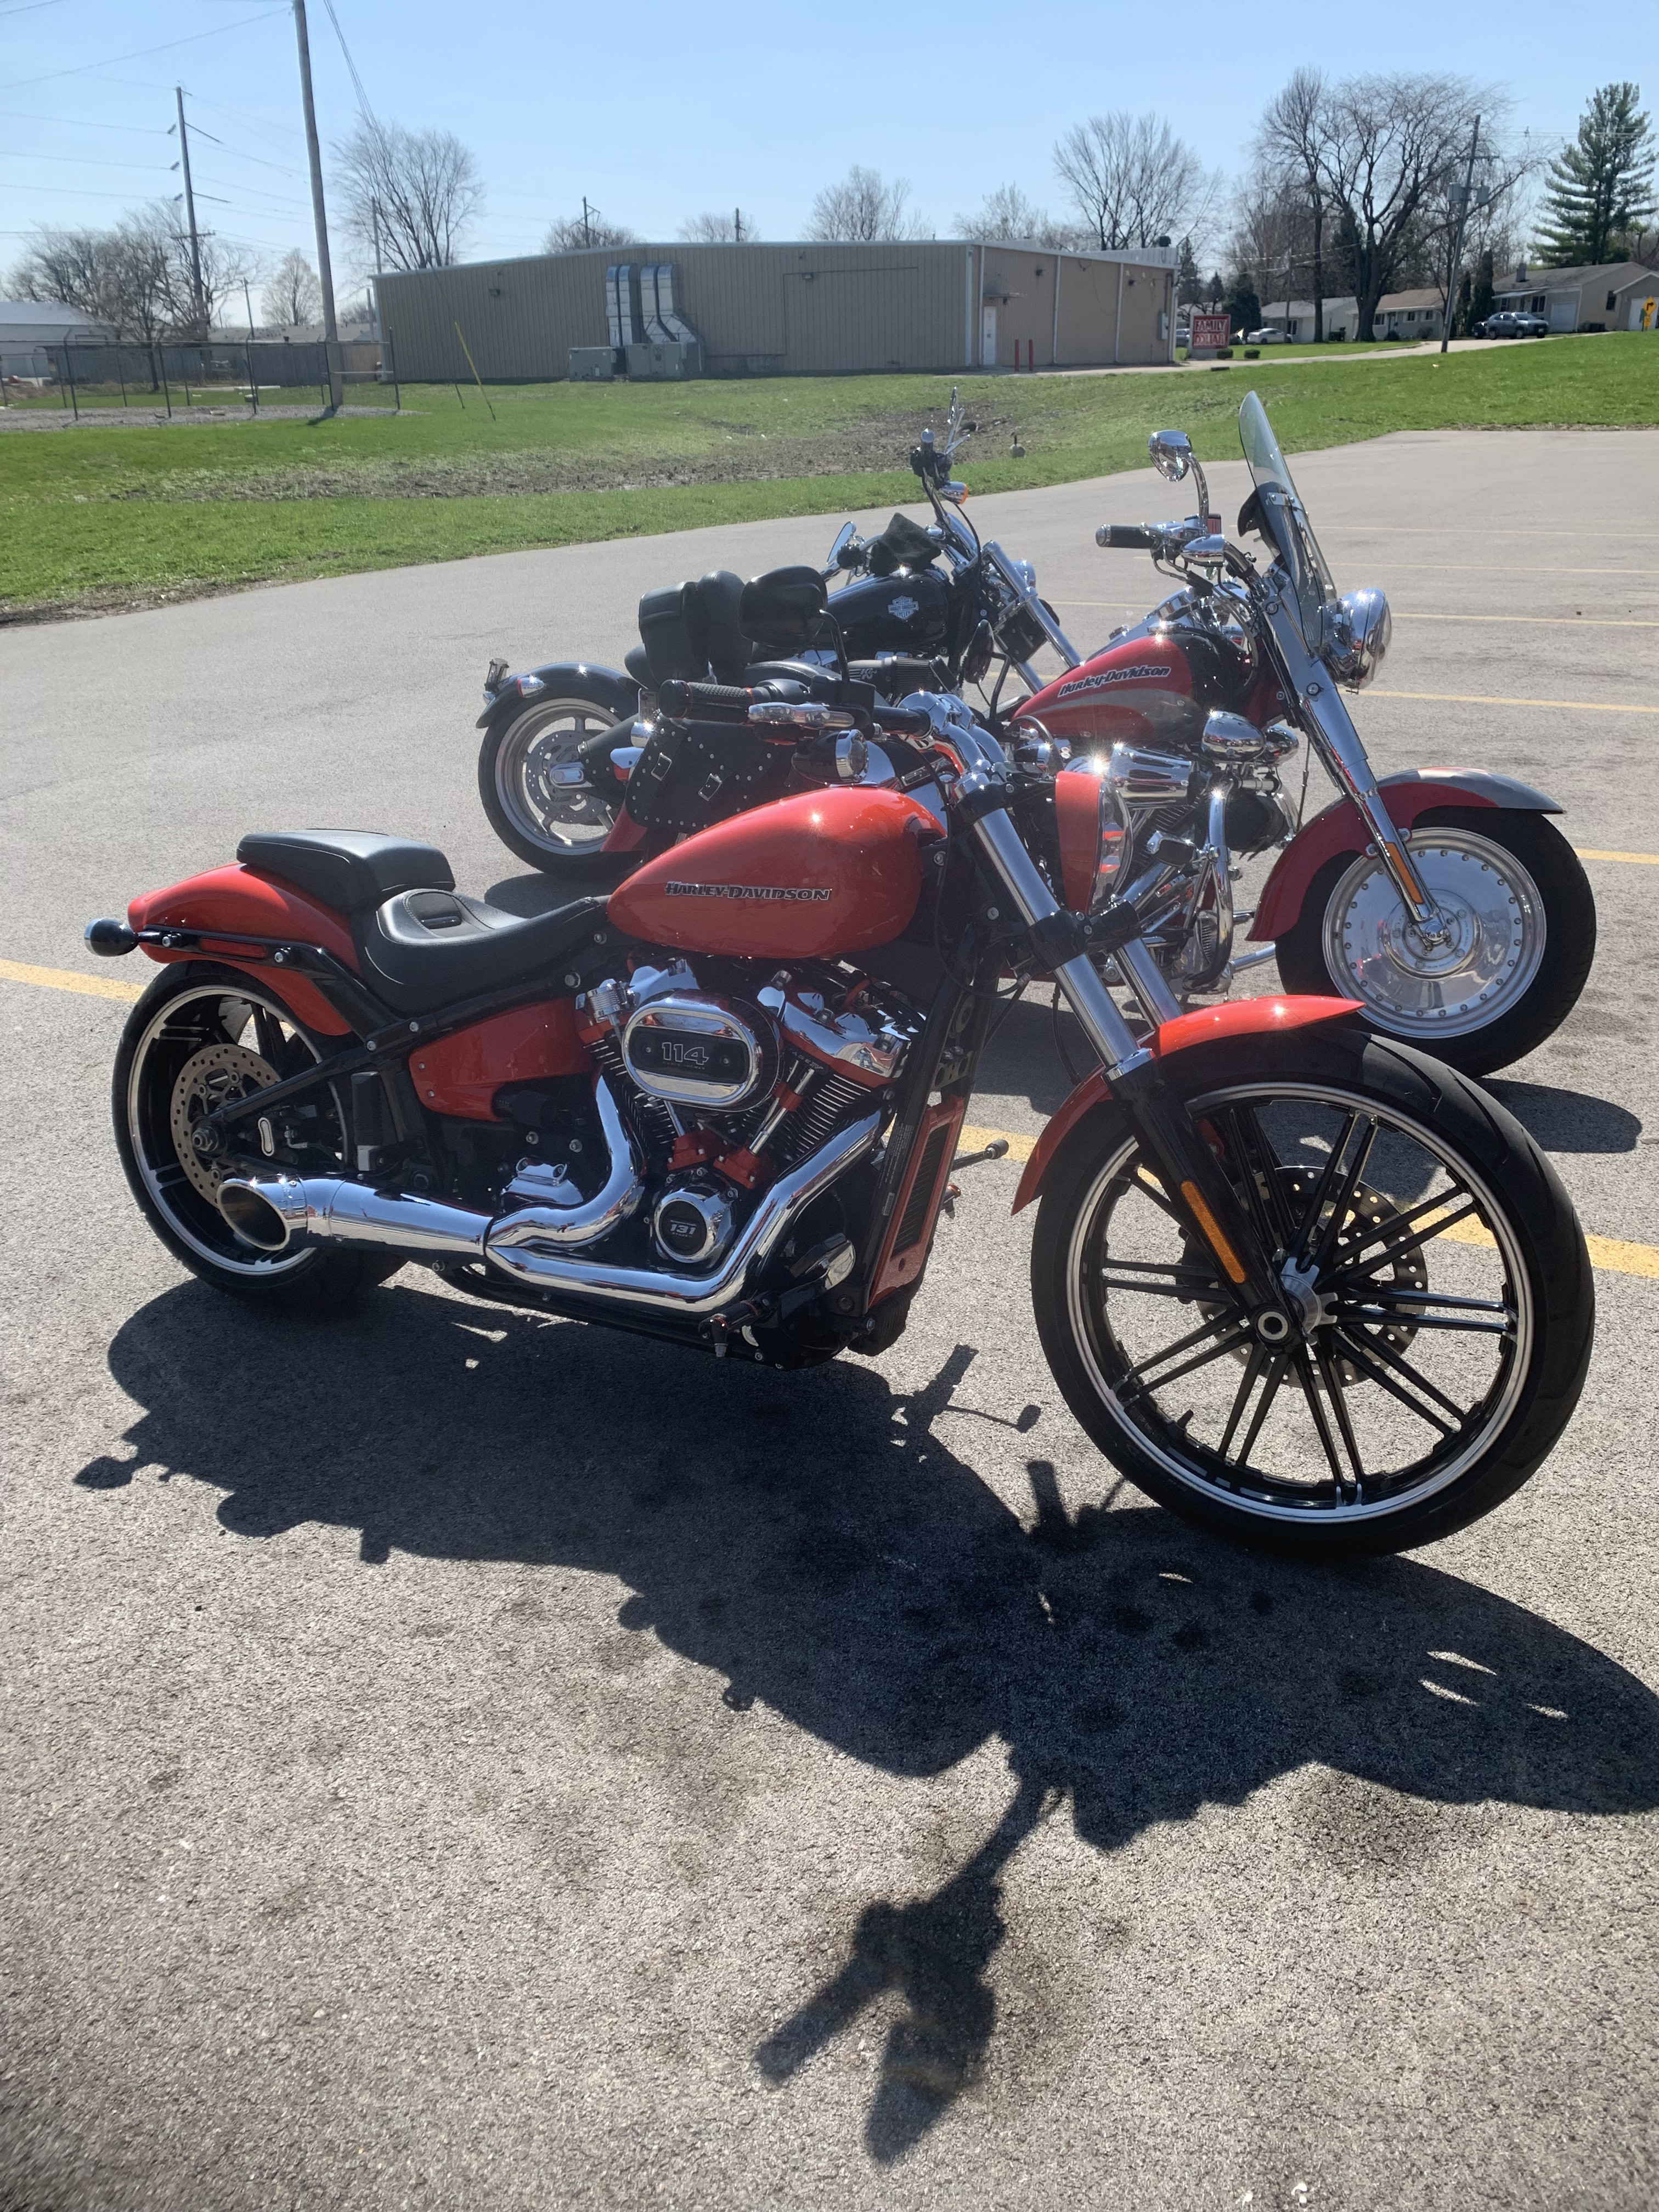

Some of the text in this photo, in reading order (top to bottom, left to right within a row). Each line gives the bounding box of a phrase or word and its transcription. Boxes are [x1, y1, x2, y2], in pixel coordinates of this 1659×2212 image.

[1195, 319, 1227, 331] FAMILY
[1194, 333, 1225, 345] DOLLAR
[665, 881, 831, 900] HARLEY-DAVIDSON
[662, 1042, 709, 1065] 114
[670, 1224, 696, 1234] 131
